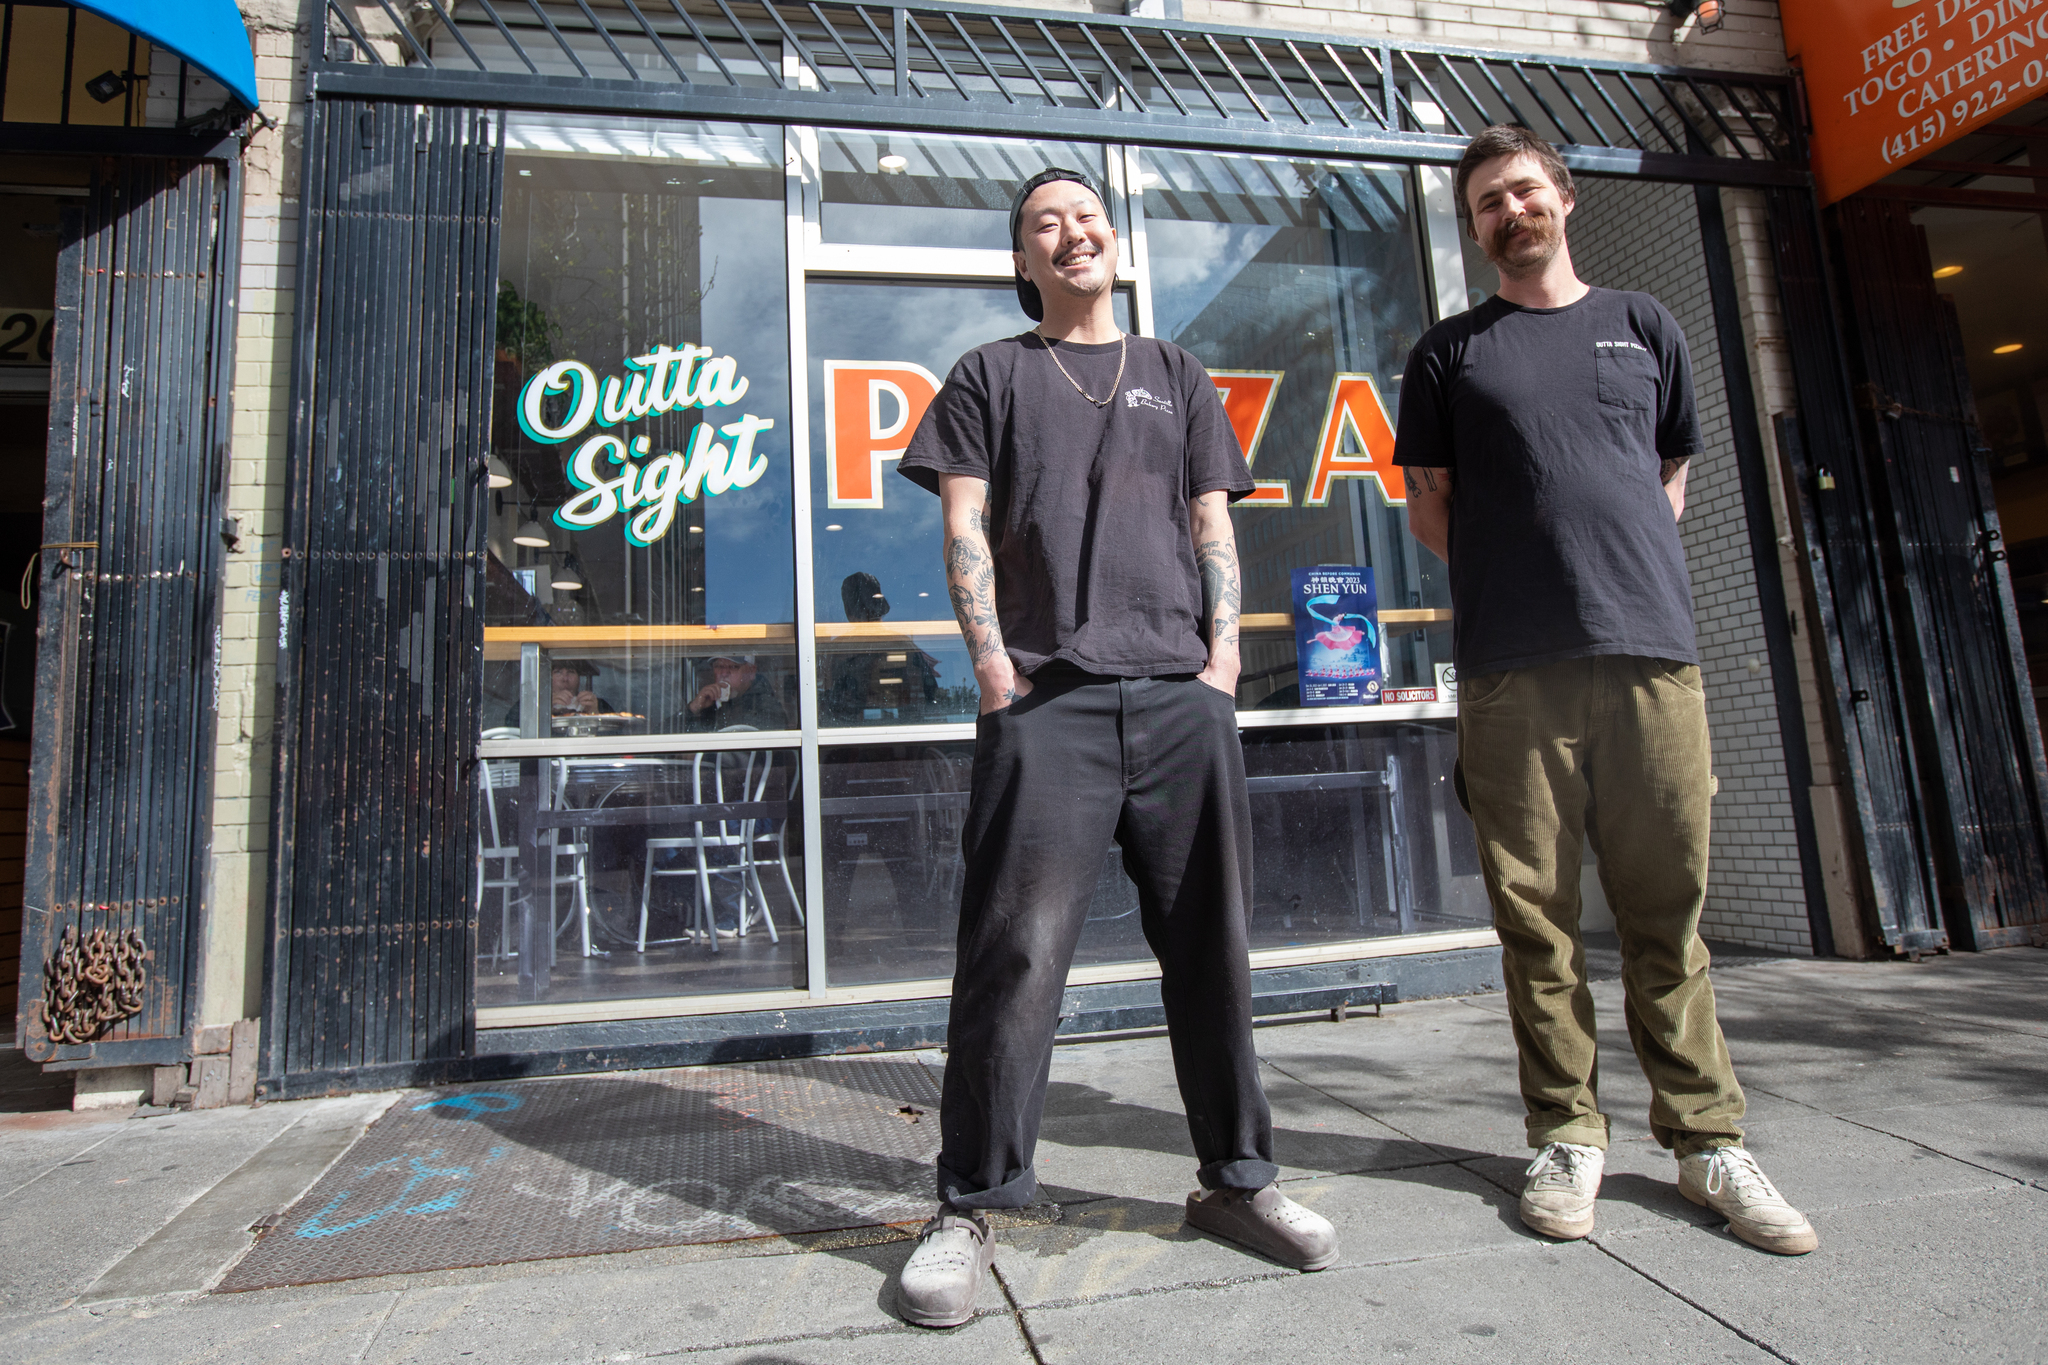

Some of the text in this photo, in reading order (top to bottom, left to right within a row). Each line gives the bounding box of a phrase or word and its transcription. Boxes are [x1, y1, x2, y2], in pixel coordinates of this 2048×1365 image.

[1860, 12, 1929, 75] FREE
[1843, 47, 1933, 117] TOGO
[1881, 52, 2048, 165] (415) 922-0
[517, 341, 750, 445] Outta
[824, 359, 1406, 508] PZA
[551, 413, 775, 548] Sight
[1303, 583, 1367, 595] SHEN YUN
[1345, 576, 1361, 585] 2023
[1384, 691, 1395, 702] NO
[1396, 689, 1435, 702] SOLICITORS
